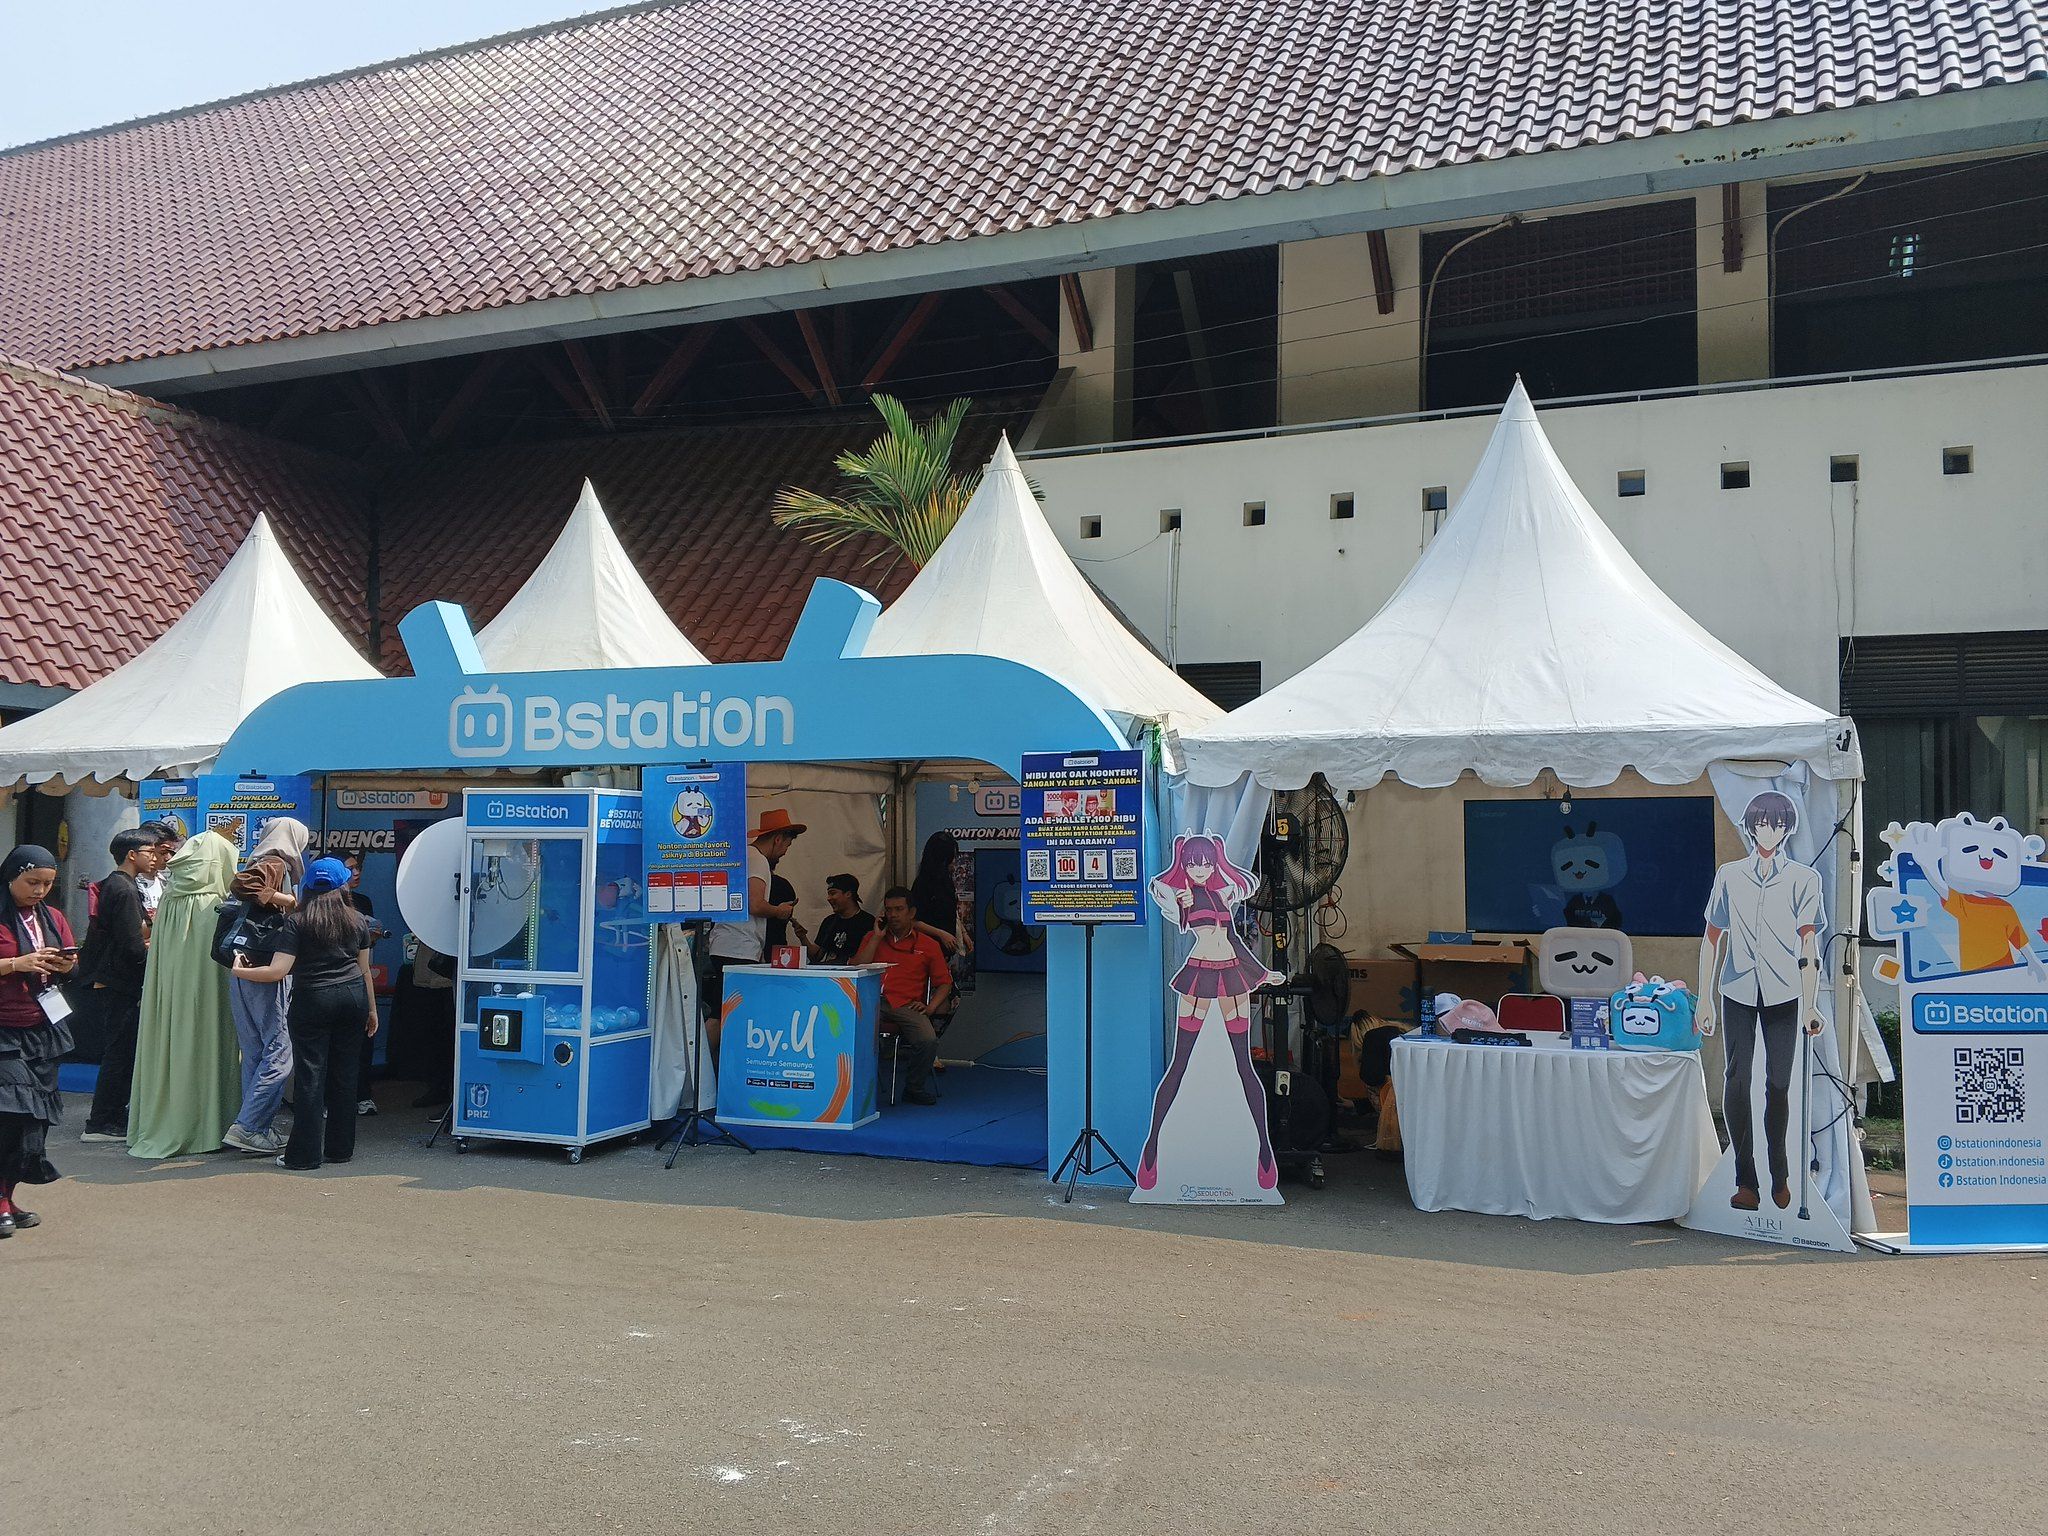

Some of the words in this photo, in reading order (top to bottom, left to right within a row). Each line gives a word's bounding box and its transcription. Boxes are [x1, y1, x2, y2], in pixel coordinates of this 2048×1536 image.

[524, 690, 795, 751] Bstation
[1022, 779, 1055, 787] JANGAN
[505, 803, 569, 820] Bstation
[1024, 817, 1044, 825] ADA
[1113, 815, 1136, 823] RIBU
[1276, 818, 1289, 836] 5
[661, 851, 687, 859] asiknya
[1058, 858, 1076, 871] 100
[1091, 857, 1099, 870] 4
[1954, 1005, 2047, 1024] Bstation
[746, 1005, 819, 1059] by.U
[1955, 1138, 2042, 1149] bstationindonesia
[1955, 1156, 2045, 1168] bstation.indonesia
[1956, 1175, 1997, 1186] Bstation
[2000, 1174, 2047, 1185] Indonesia
[1744, 1215, 1783, 1231] ATRI
[1801, 1238, 1830, 1247] Bstation
